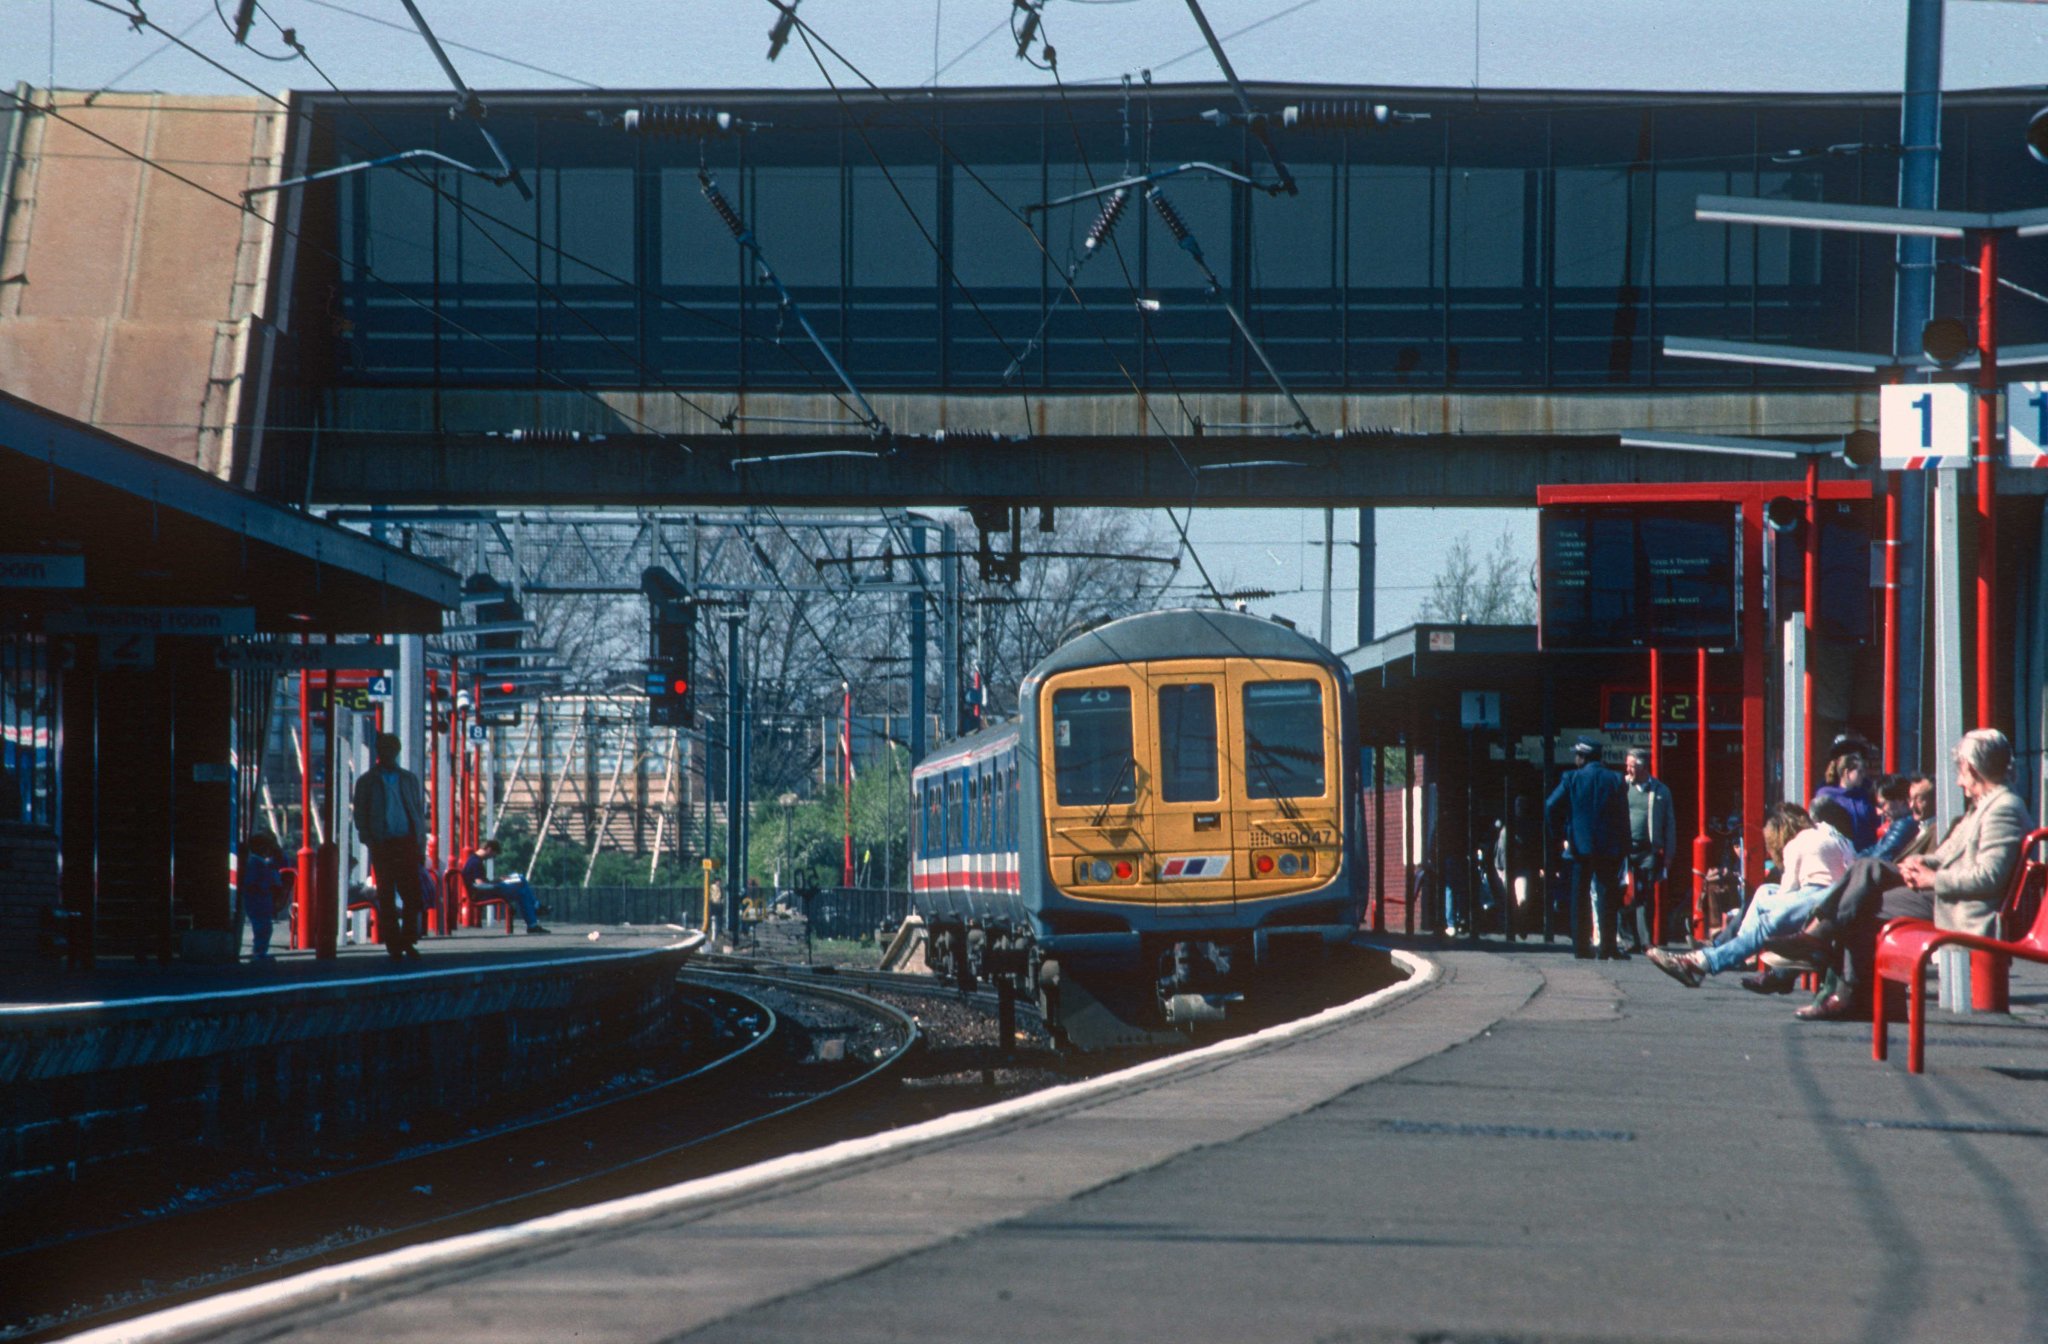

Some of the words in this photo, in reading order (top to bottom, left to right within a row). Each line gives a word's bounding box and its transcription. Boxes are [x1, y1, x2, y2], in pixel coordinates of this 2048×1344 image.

[1911, 393, 1932, 448] 1
[2029, 392, 2048, 446] 1
[168, 612, 220, 628] room
[373, 678, 387, 694] 4
[1475, 693, 1486, 720] 1
[473, 726, 483, 738] 8
[1610, 731, 1634, 743] Way
[742, 896, 767, 921] 20
